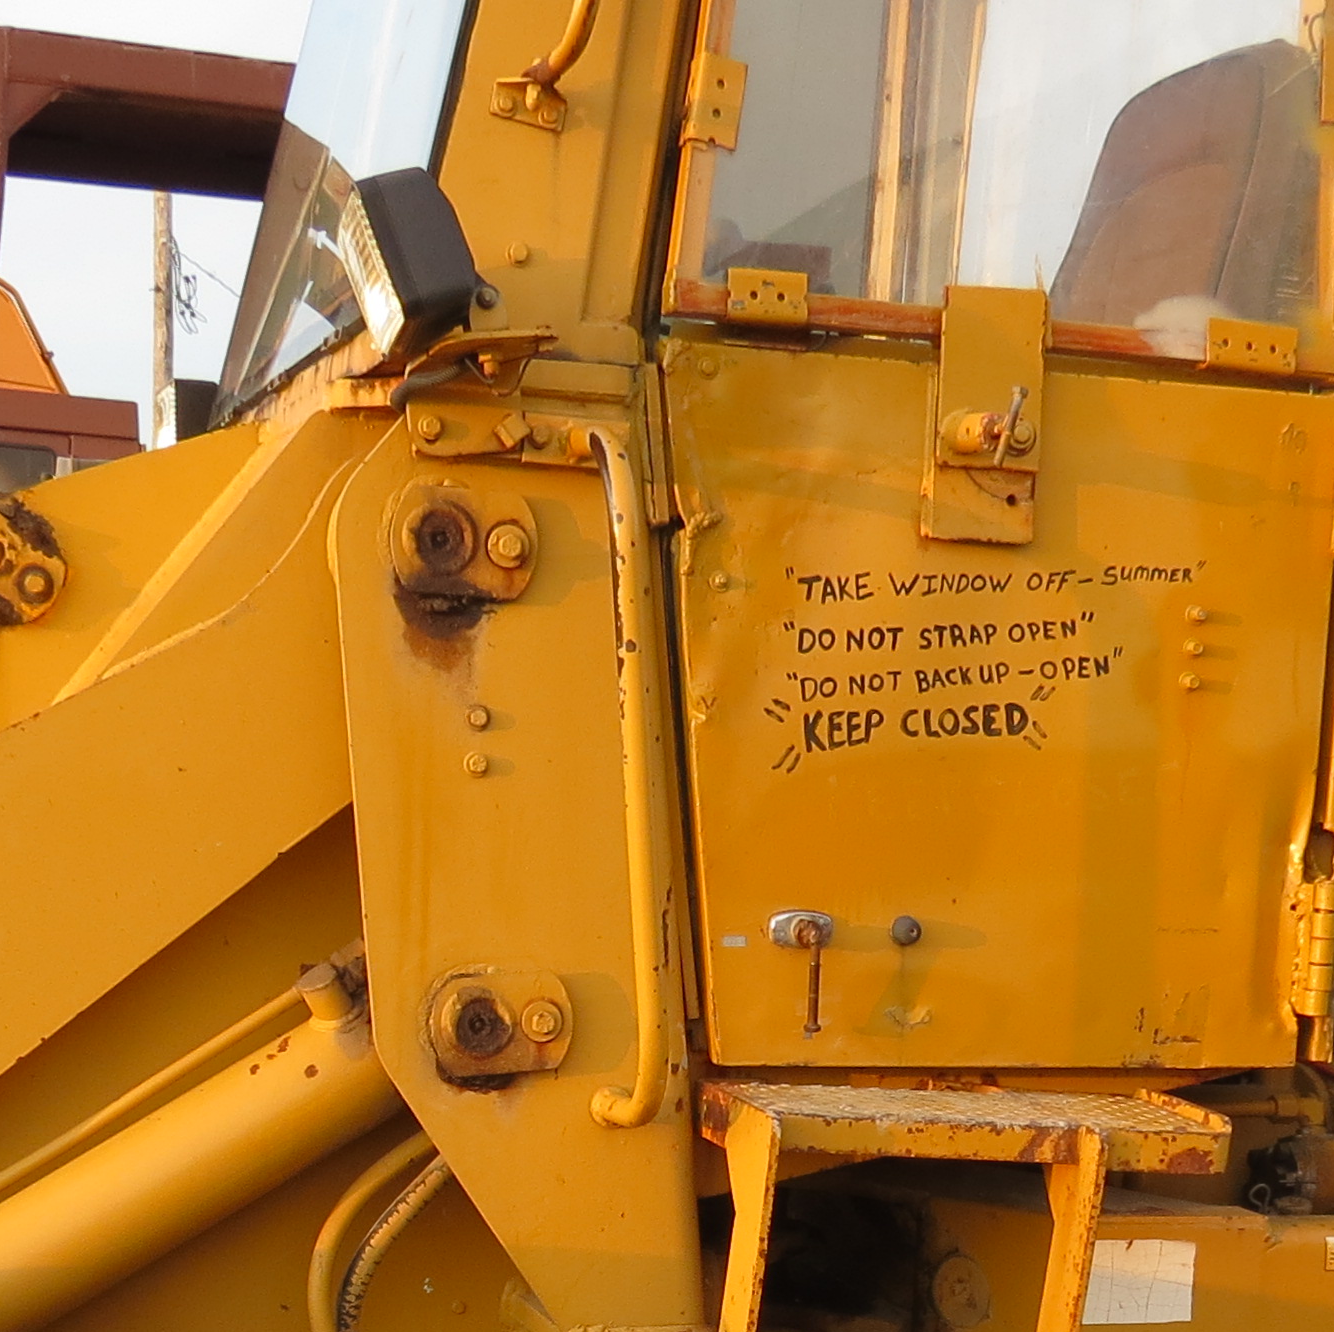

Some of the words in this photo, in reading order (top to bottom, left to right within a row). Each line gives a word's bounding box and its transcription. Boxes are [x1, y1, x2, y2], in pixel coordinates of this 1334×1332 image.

[889, 573, 1012, 597] WINDOW
[846, 626, 904, 652] NOT
[919, 623, 997, 650] STRAP
[848, 671, 902, 695] NOT
